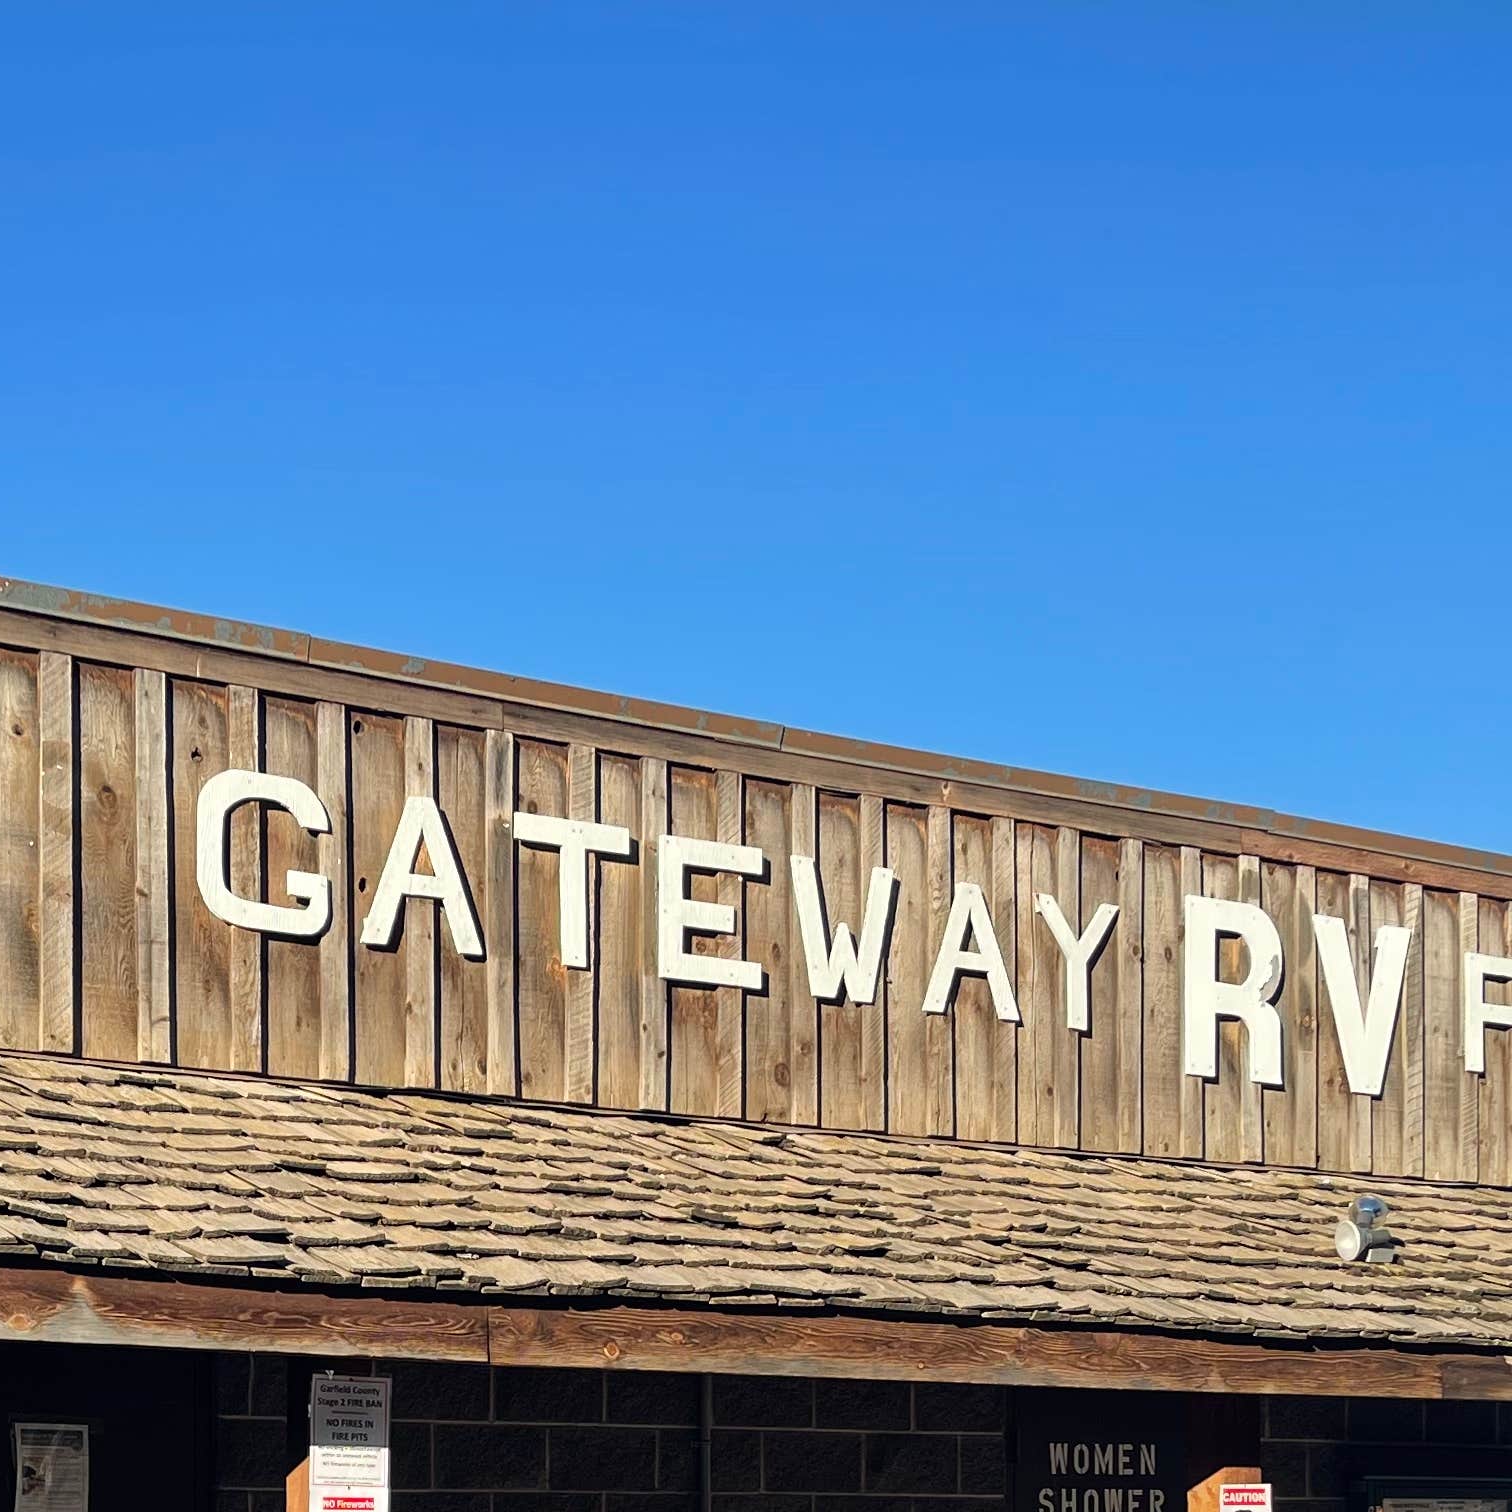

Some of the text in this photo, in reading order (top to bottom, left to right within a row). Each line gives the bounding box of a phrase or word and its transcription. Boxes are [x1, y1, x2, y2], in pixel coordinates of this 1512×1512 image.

[196, 768, 1120, 1032] GATEWAY
[1185, 893, 1412, 1096] RV
[320, 1384, 380, 1397] Garfield County
[317, 1397, 338, 1408] Stage
[347, 1399, 364, 1408] FIRE
[365, 1399, 383, 1409] BAN
[326, 1419, 374, 1429] NO FIRES IN
[332, 1432, 368, 1442] FIRE PITS
[1049, 1442, 1156, 1475] WOMEN
[1223, 1493, 1266, 1503] CAUTION
